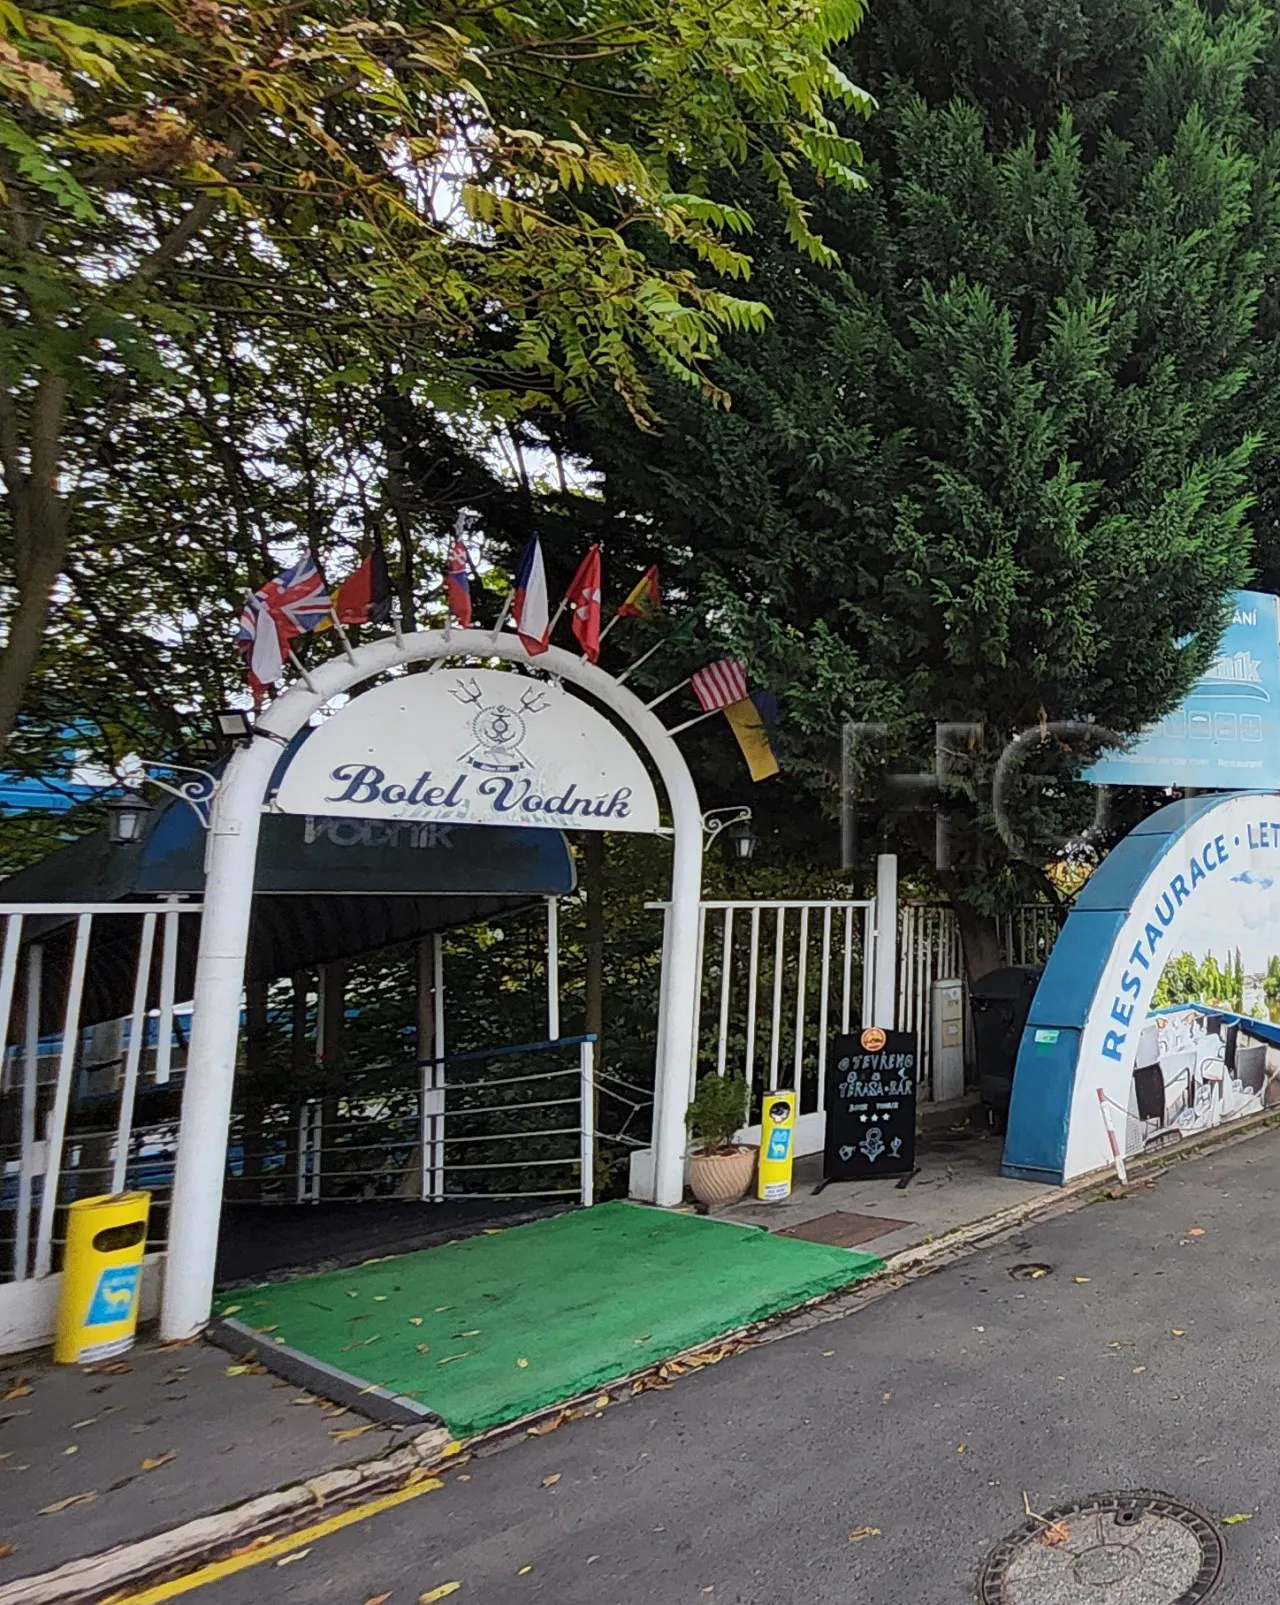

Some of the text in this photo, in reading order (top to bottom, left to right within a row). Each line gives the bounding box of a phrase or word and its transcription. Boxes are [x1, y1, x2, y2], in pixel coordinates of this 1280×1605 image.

[325, 762, 633, 819] Botel Vodník
[1101, 832, 1230, 1063] RESTAURACE
